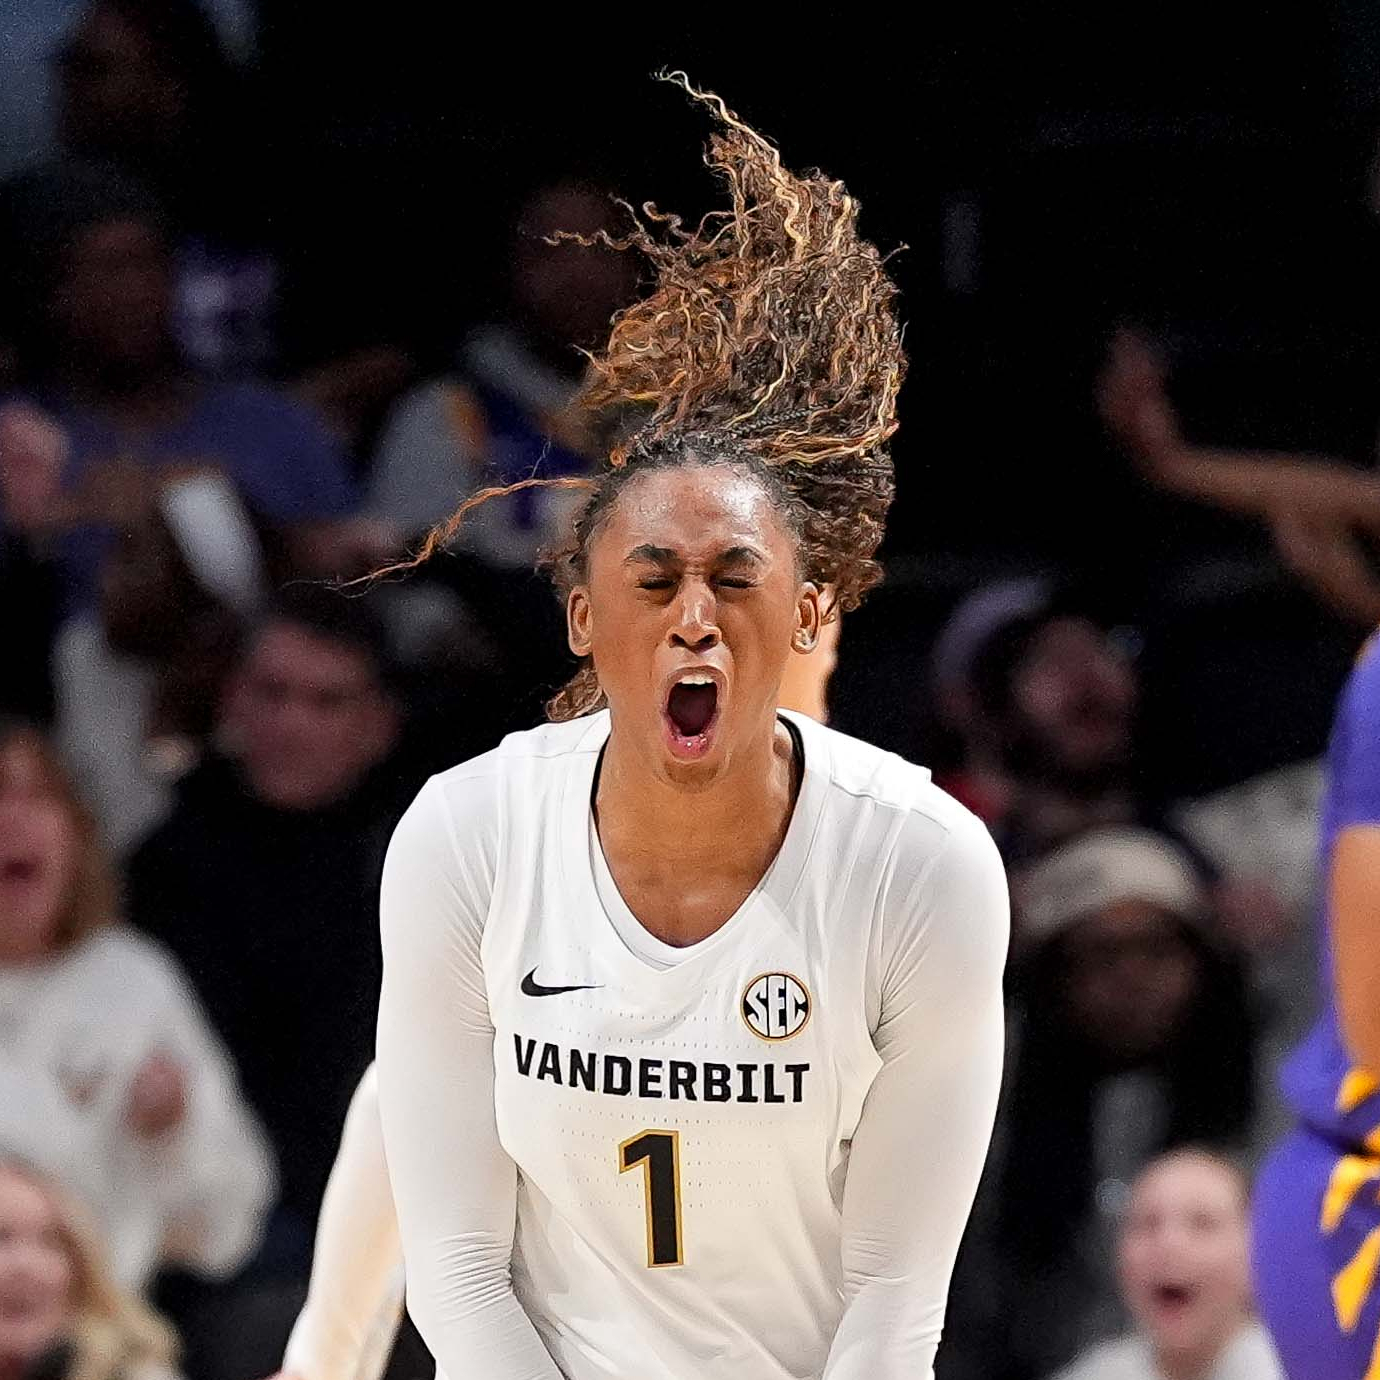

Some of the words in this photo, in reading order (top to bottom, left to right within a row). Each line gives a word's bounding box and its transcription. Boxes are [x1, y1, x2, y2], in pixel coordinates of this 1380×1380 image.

[742, 973, 808, 1038] SEC
[513, 1033, 810, 1103] VANDERBILT
[618, 1128, 684, 1268] 1
